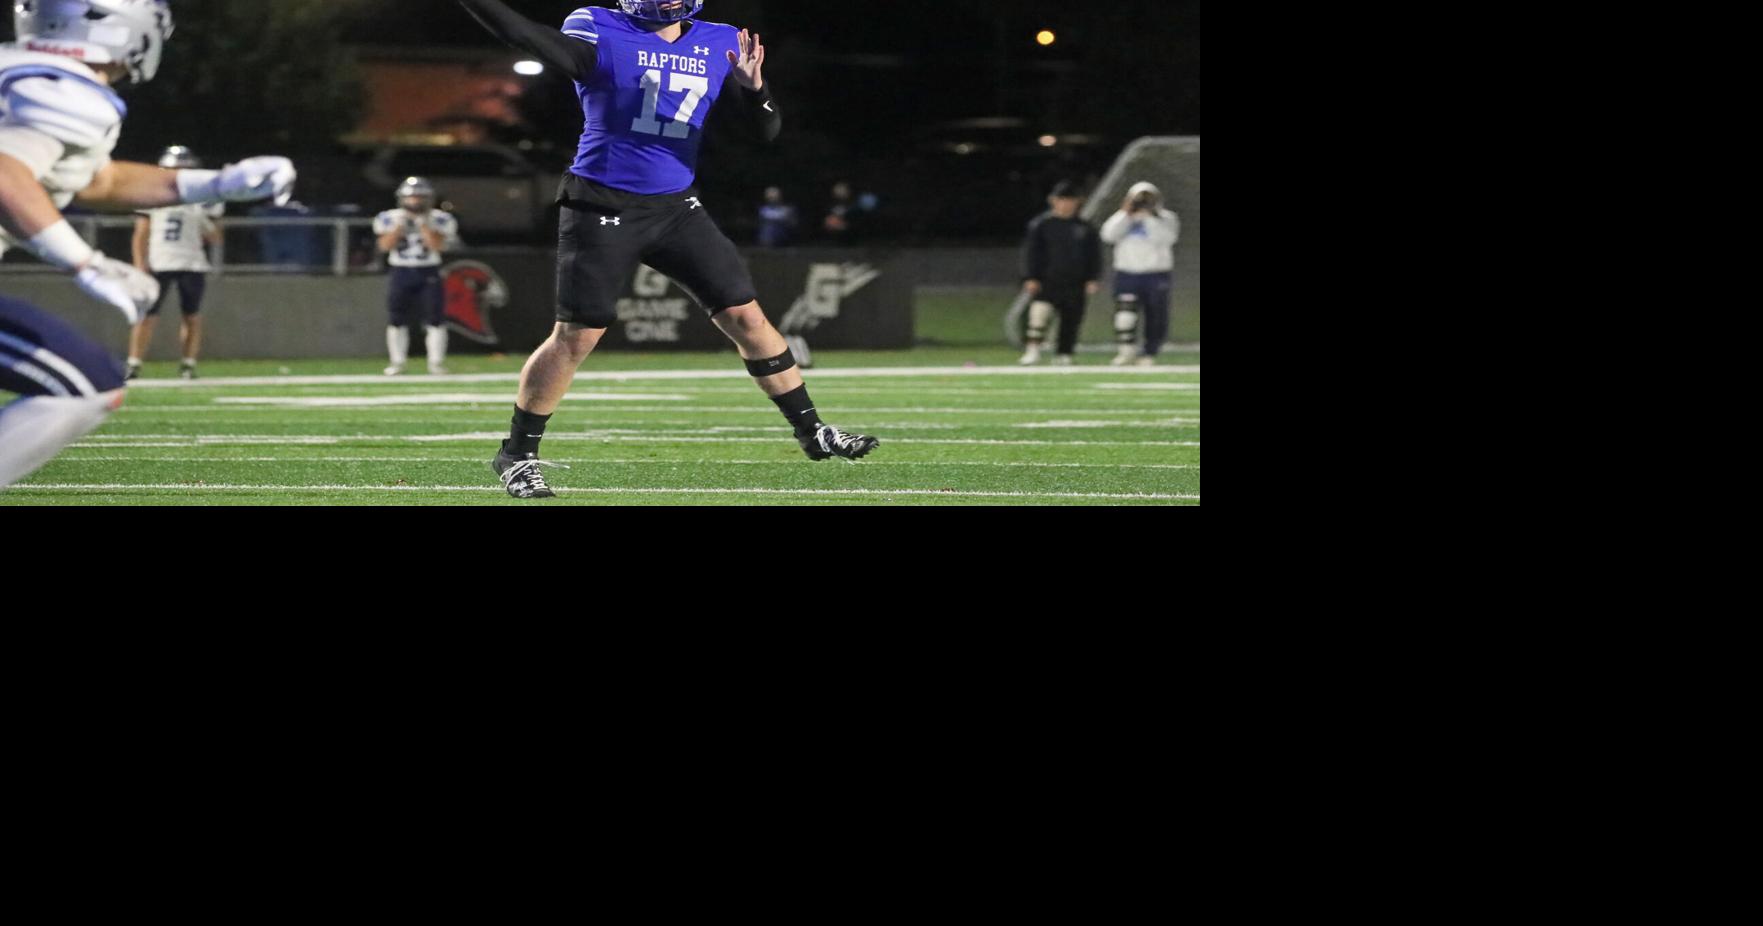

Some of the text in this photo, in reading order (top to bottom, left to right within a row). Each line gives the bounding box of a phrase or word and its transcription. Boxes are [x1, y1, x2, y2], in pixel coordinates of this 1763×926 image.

[637, 50, 707, 75] RAPTORS
[630, 68, 709, 139] 17
[615, 297, 689, 321] GAME
[624, 320, 680, 342] ONE
